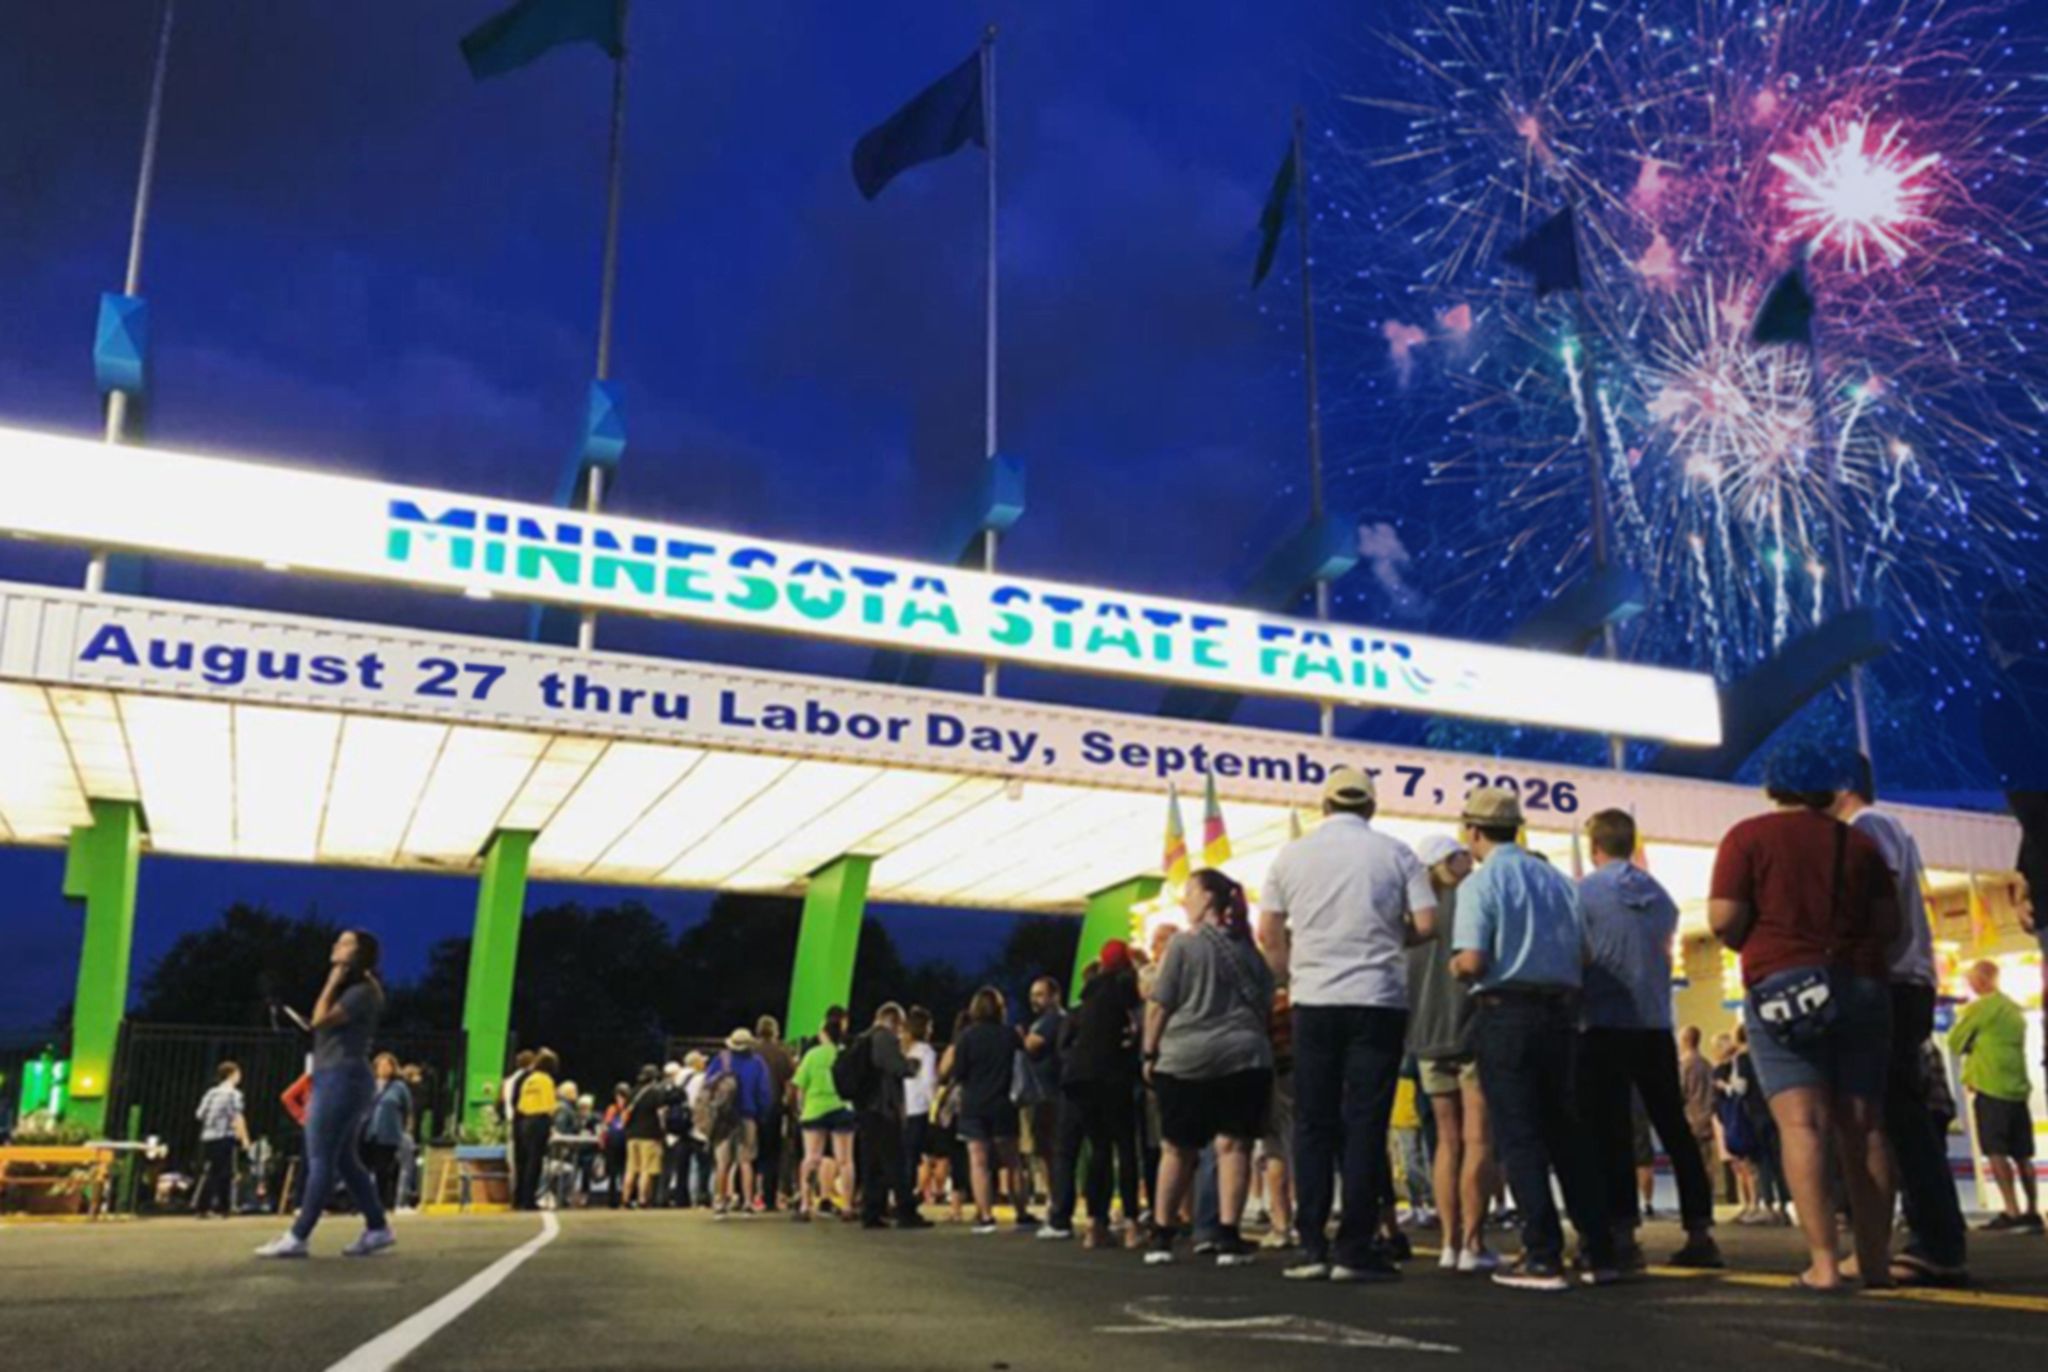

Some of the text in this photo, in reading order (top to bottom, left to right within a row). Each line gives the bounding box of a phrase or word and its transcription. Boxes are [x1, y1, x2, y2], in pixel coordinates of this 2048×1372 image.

[387, 500, 1435, 694] MINNESOTA STATE FAIR
[79, 624, 384, 688] August
[415, 658, 507, 701] 27
[539, 672, 689, 720] thru
[719, 690, 910, 742] Labor
[926, 713, 1056, 764] Day,
[1082, 731, 1380, 785] Septembr
[1395, 765, 1444, 805] 7,
